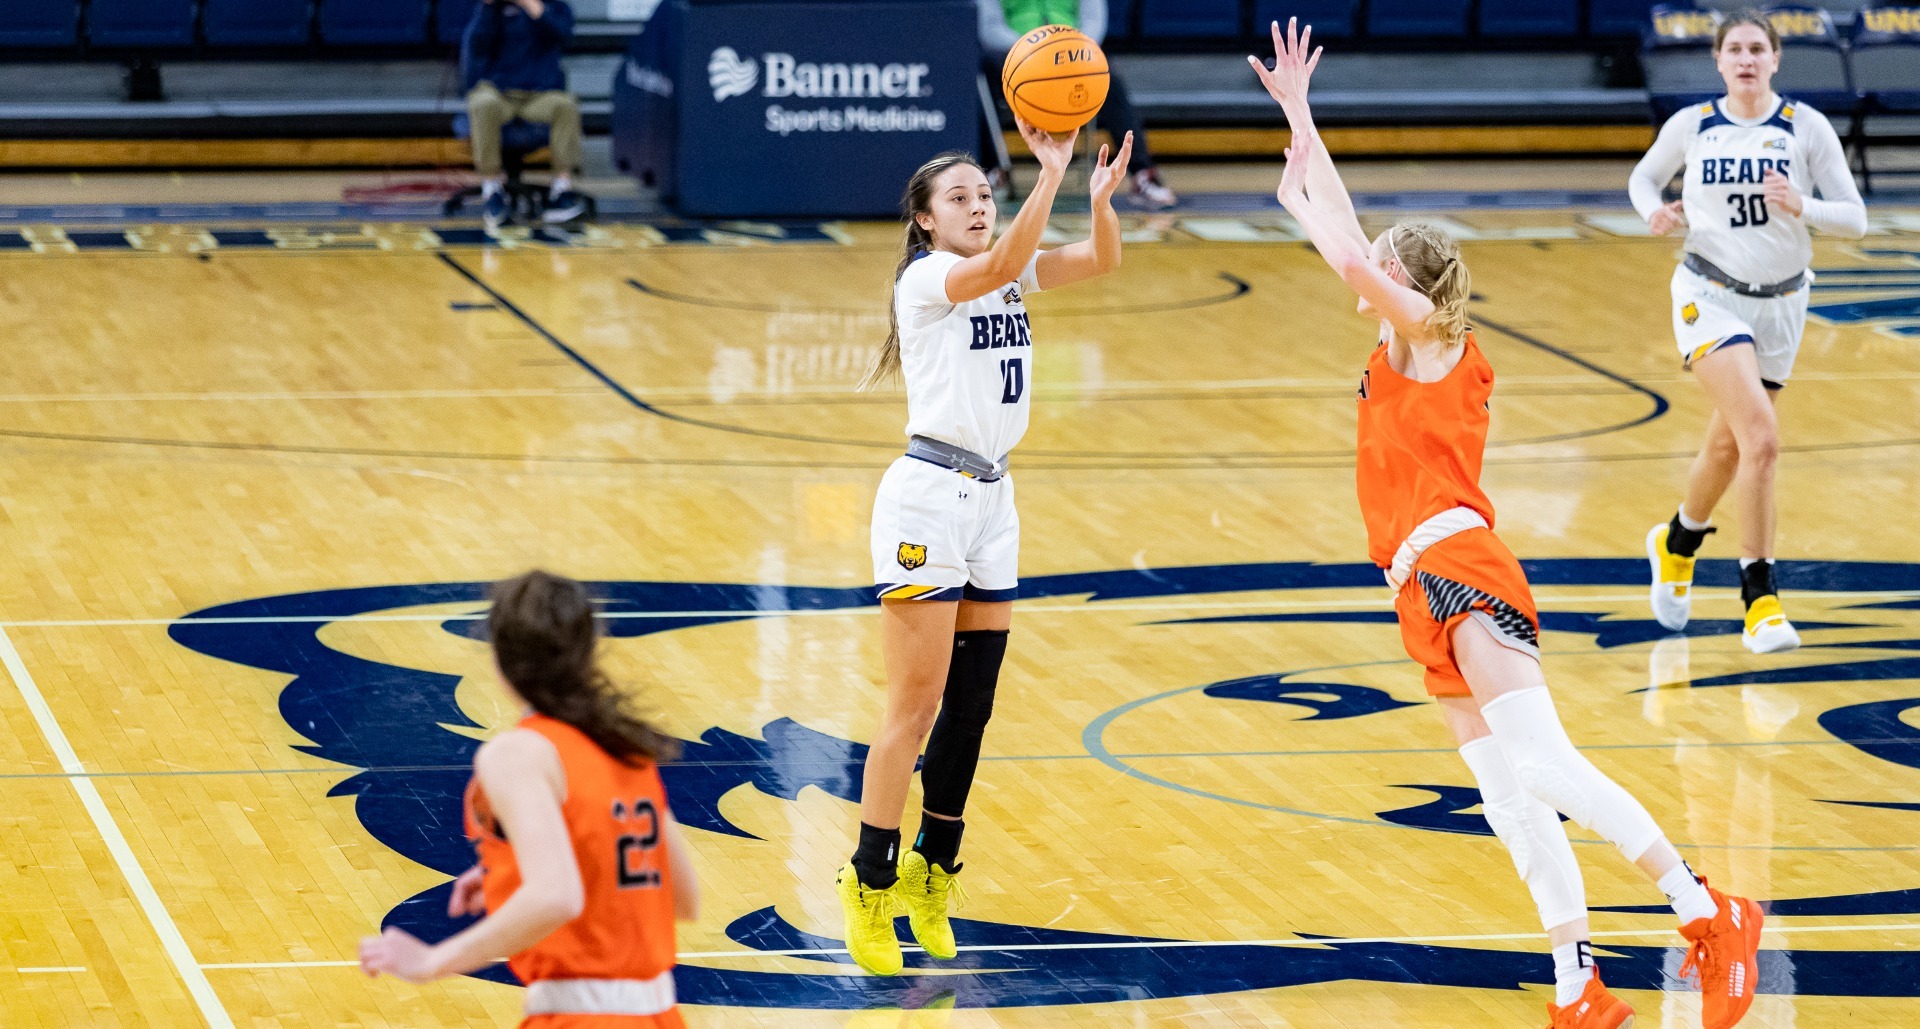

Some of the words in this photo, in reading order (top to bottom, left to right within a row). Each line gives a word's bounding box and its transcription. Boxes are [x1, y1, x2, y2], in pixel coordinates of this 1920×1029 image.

[1054, 48, 1092, 66] EVO
[762, 52, 930, 98] Banner
[765, 105, 844, 137] Sports
[845, 105, 947, 132] Medicine
[1702, 158, 1790, 185] BEARS
[1727, 194, 1769, 227] 30
